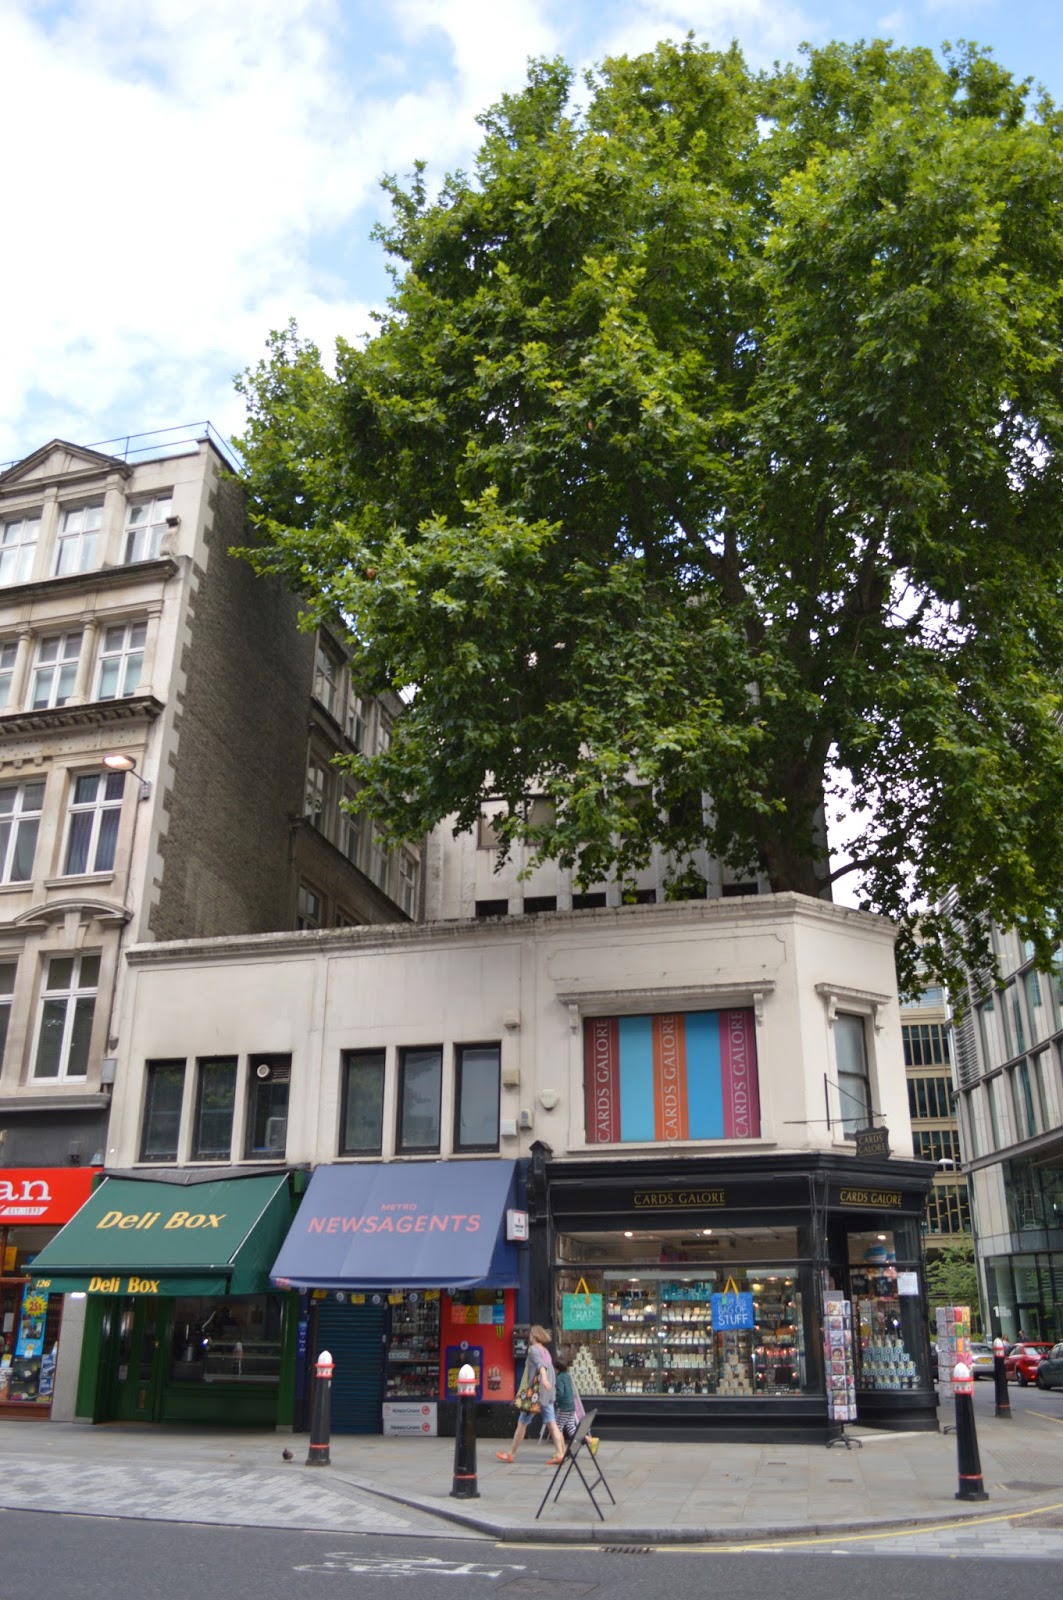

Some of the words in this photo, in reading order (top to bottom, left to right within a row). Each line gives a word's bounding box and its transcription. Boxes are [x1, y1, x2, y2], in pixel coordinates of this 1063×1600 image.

[597, 1019, 610, 1083] GALORE
[662, 1016, 676, 1080] GALORE
[730, 1012, 746, 1076] GALORE
[598, 1088, 610, 1143] CARDS
[664, 1085, 678, 1141] CARDS
[734, 1082, 749, 1138] CARDS
[857, 1142, 886, 1154] GALORE
[858, 1134, 884, 1145] CARDS
[633, 1193, 674, 1205] CARDS
[678, 1191, 725, 1204] GALORE
[840, 1191, 868, 1203] CARDS
[870, 1193, 902, 1205] GALORE
[380, 1203, 418, 1212] METRO
[96, 1210, 162, 1230] Deli
[163, 1210, 228, 1230] Box
[306, 1214, 482, 1234] NEWSAGENTS
[36, 1279, 52, 1288] 126
[88, 1276, 121, 1293] Deli
[127, 1276, 160, 1293] Box
[718, 1313, 749, 1326] STUFF
